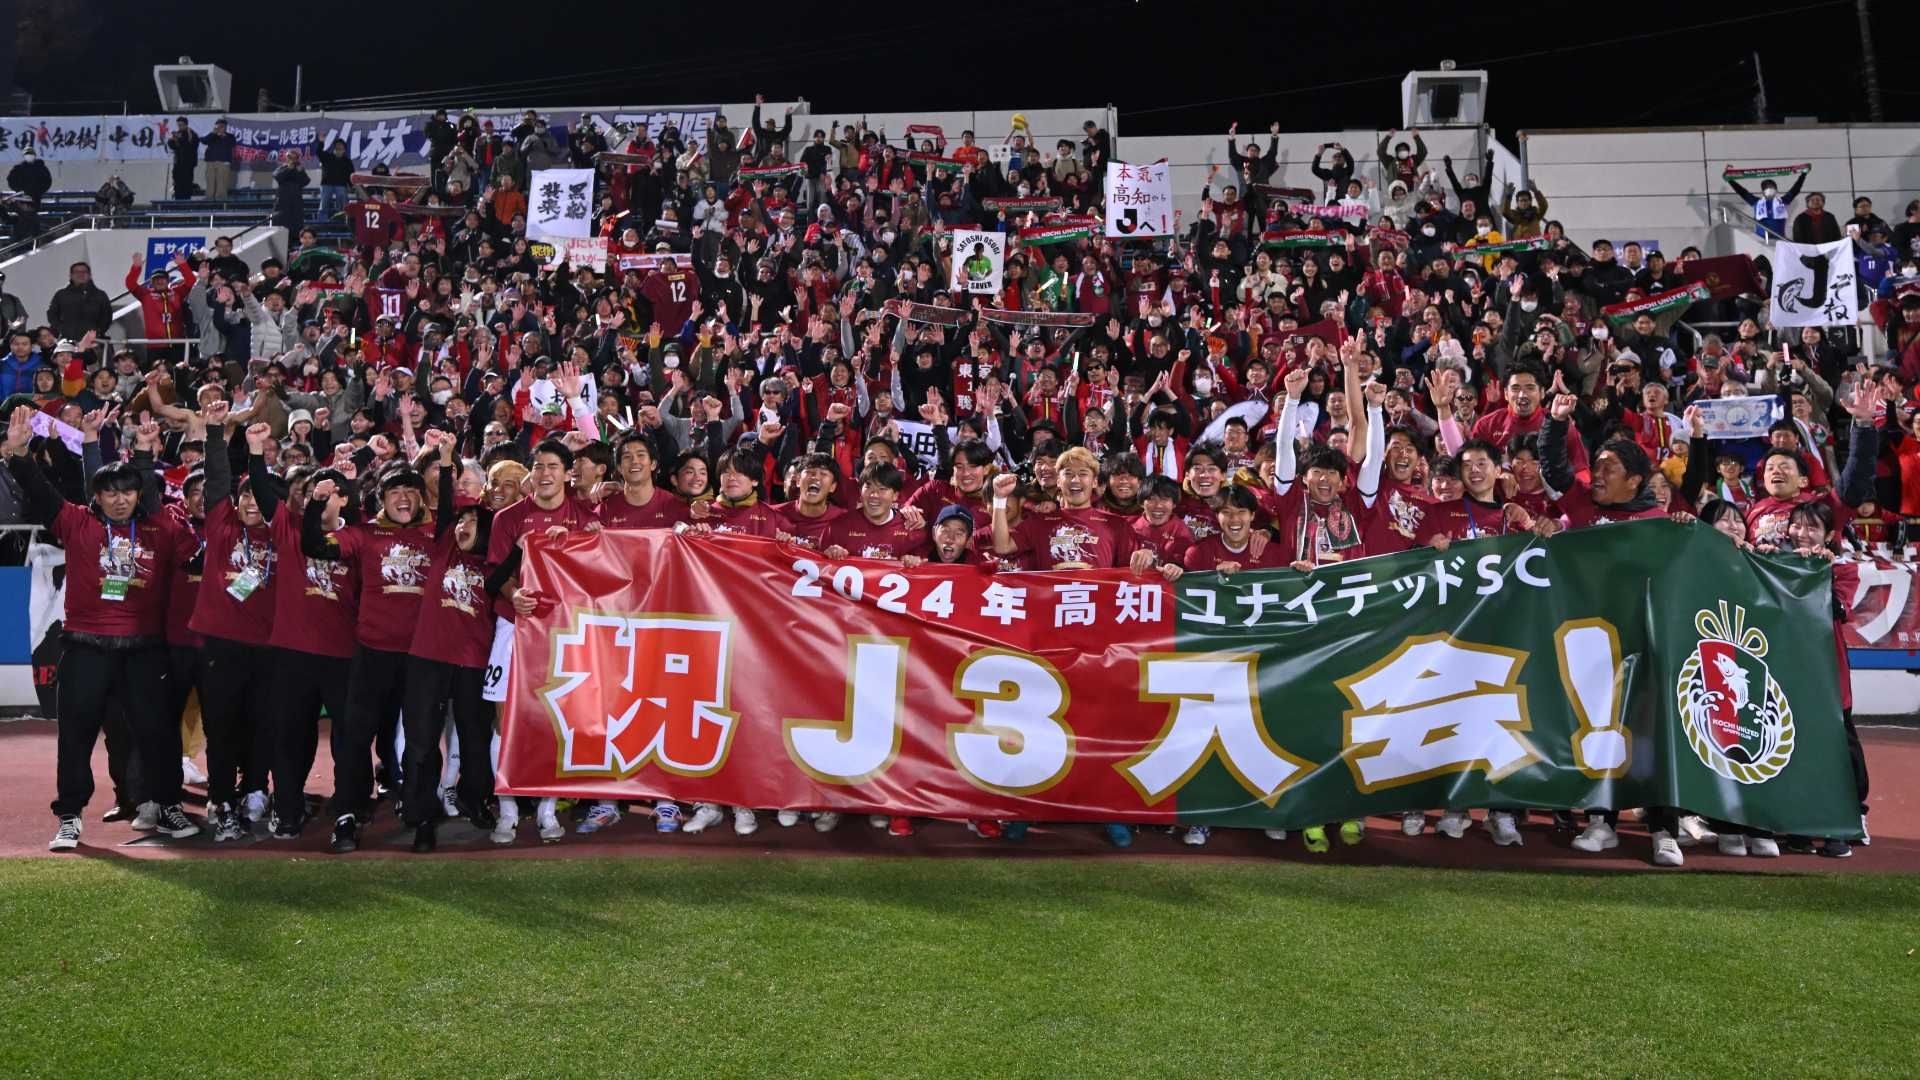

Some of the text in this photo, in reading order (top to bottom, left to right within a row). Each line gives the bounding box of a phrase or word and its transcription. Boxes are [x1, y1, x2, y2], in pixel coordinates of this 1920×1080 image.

[109, 125, 154, 152] 中田
[1117, 161, 1164, 183] 本気で
[564, 182, 588, 220] 黒船
[1113, 184, 1167, 206] 高知から
[365, 210, 380, 229] 12
[957, 234, 983, 253] SATOSHI
[670, 281, 687, 303] 12
[970, 281, 993, 290] SAVER
[381, 293, 401, 317] 10
[1633, 301, 1658, 312] KOCHI
[1657, 291, 1688, 305] UNITED
[541, 613, 735, 777] 祝
[1712, 718, 1760, 738] KOCHI UNITED
